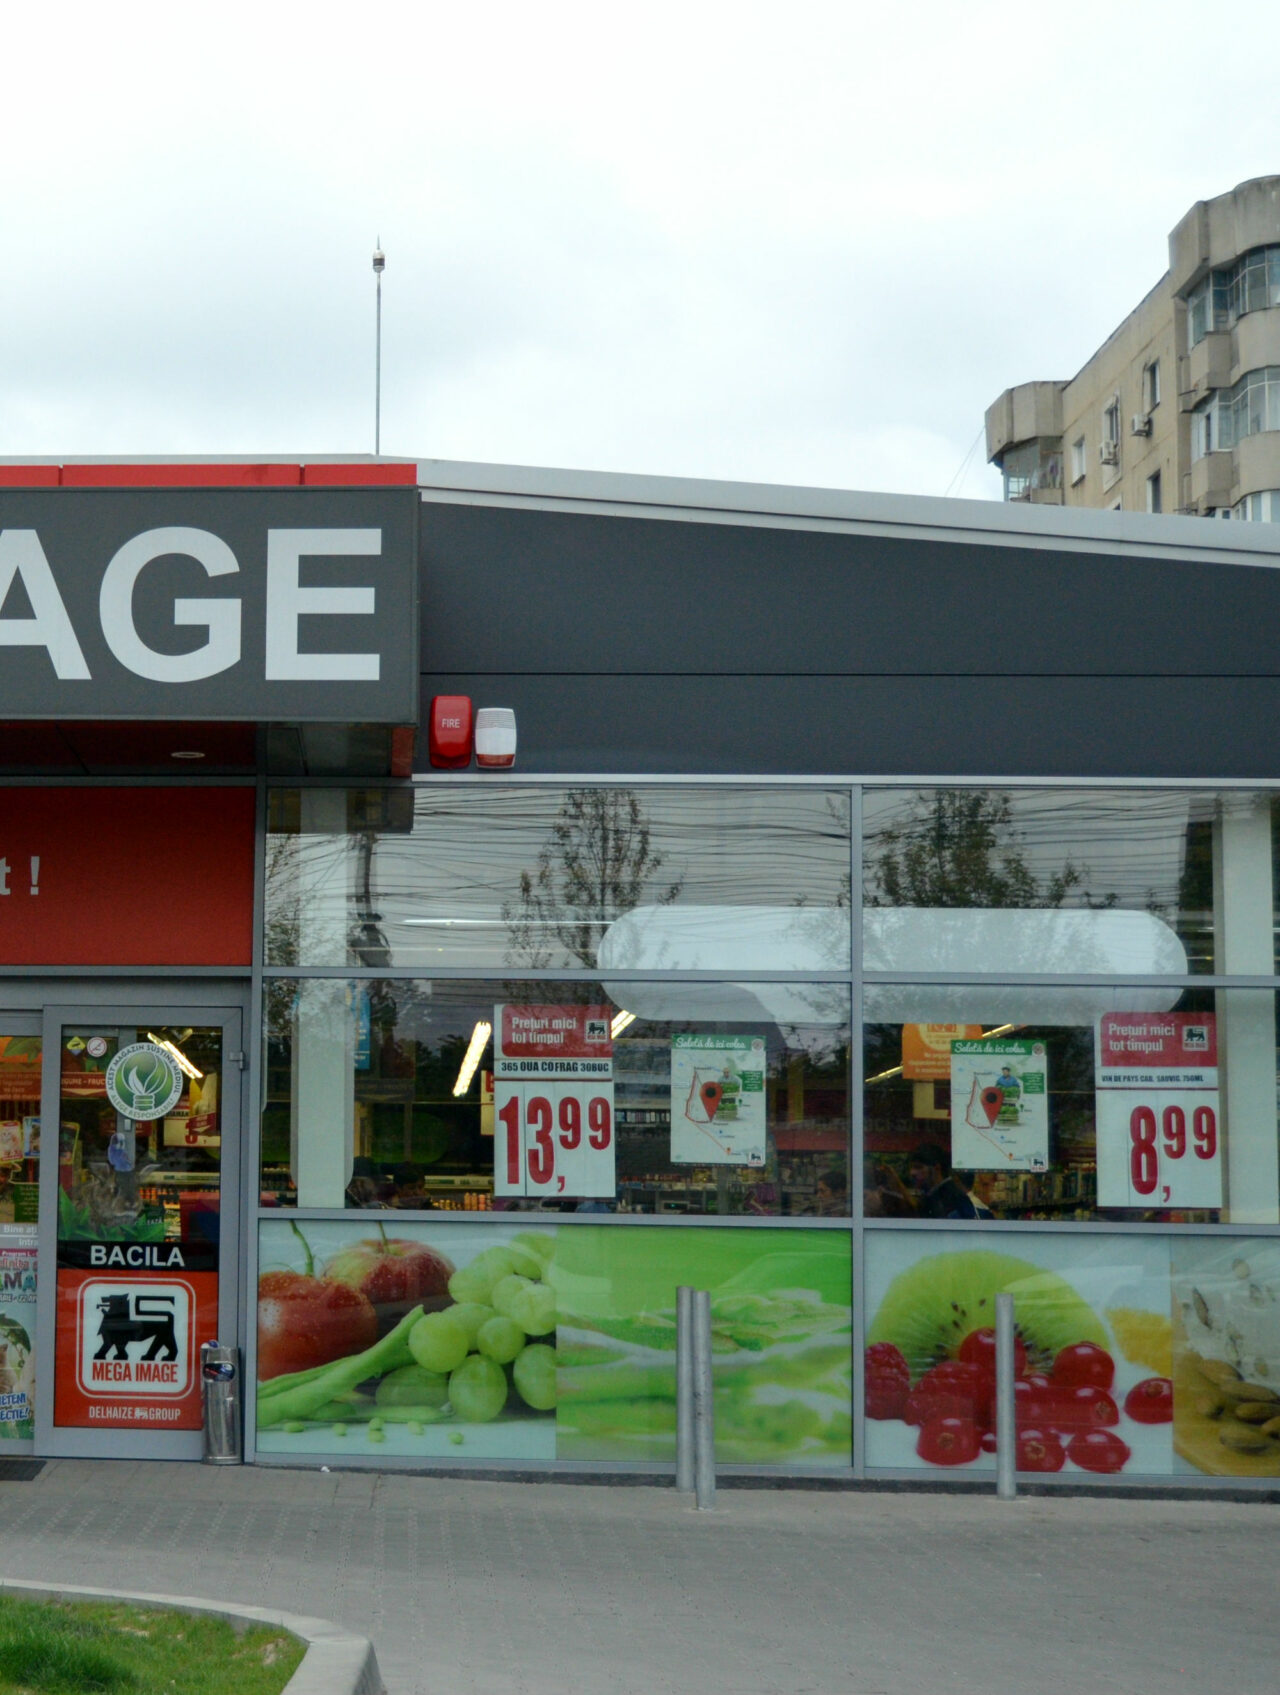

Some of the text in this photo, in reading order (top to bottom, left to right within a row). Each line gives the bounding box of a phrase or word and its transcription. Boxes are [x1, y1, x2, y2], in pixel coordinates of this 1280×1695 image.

[441, 718, 461, 728] FIRE
[552, 1017, 577, 1029] mici
[1150, 1024, 1176, 1036] mici
[512, 1032, 564, 1045] tot timpul
[1109, 1039, 1163, 1054] tot timpul
[113, 1044, 144, 1066] MAGAZIN
[146, 1044, 175, 1065] SUSTINE
[501, 1062, 519, 1072] 365
[520, 1062, 540, 1072] OUA
[90, 1245, 185, 1267] BACILA
[92, 1362, 178, 1383] MEGA IMAGE
[89, 1406, 181, 1421] DELHAIZE GROUP
